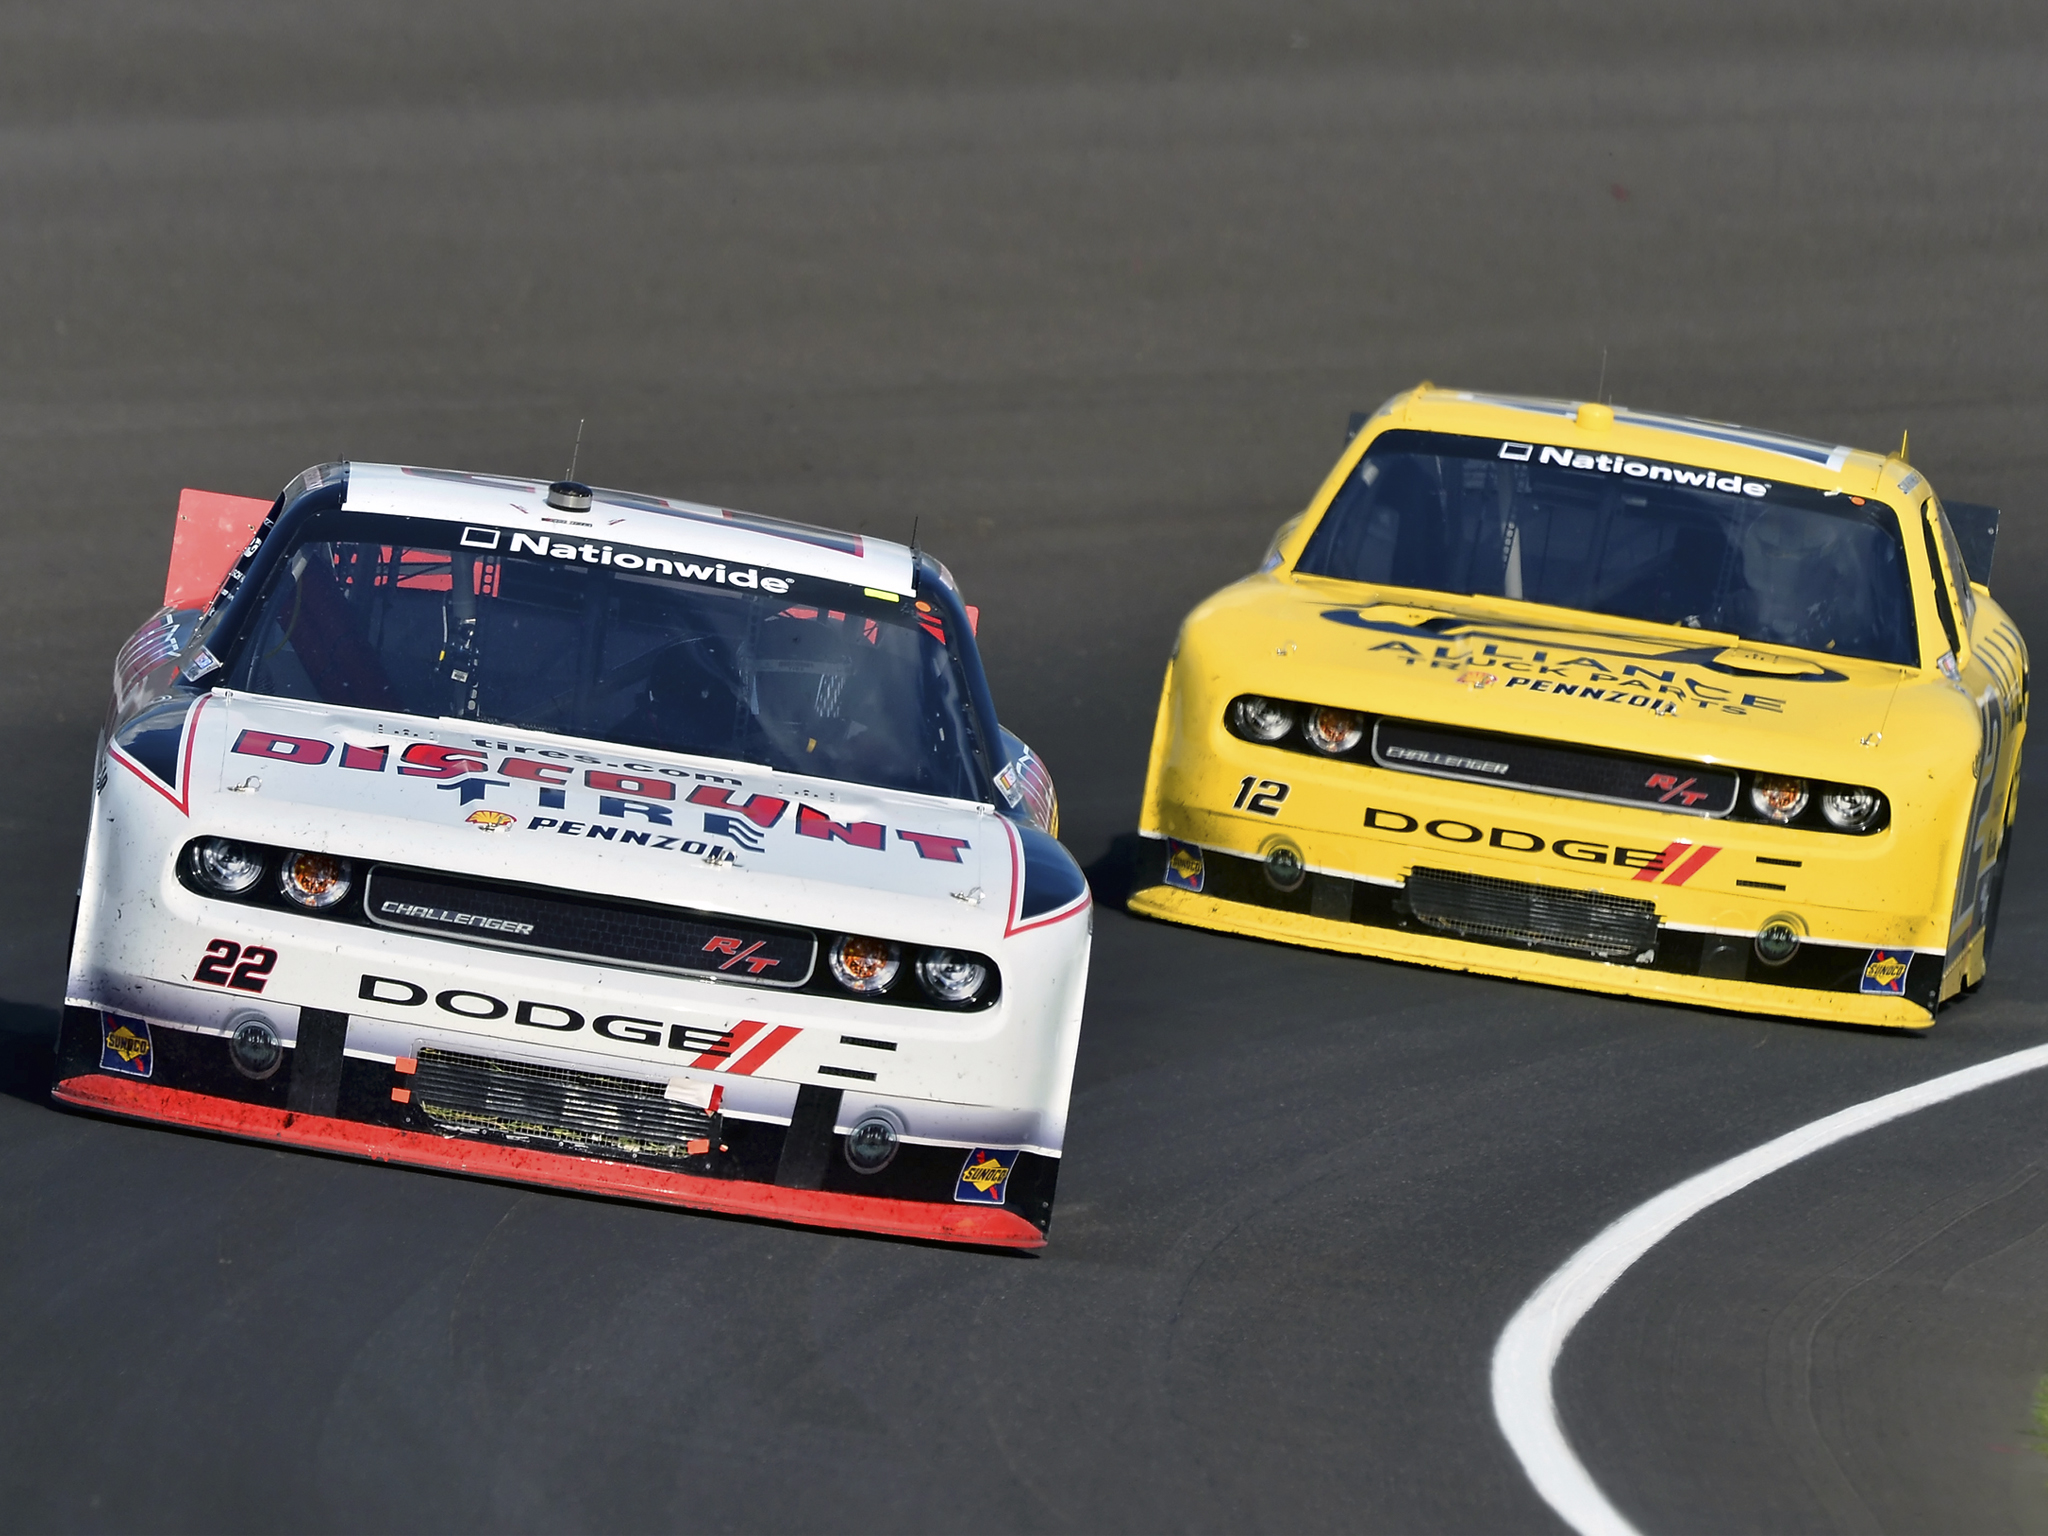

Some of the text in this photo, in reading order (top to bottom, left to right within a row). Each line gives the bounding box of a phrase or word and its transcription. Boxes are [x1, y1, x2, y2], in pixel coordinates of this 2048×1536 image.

[1539, 446, 1767, 497] Nationwide
[509, 532, 790, 594] Nationwide
[1367, 641, 1786, 713] ALLIANCE
[1398, 655, 1747, 715] TRUCK PARTS
[471, 738, 742, 786] tires.com
[1385, 745, 1509, 775] CHALLENGER
[230, 728, 971, 864] DISCOUNT
[1232, 774, 1291, 817] 12
[1645, 772, 1708, 806] R/T
[436, 777, 766, 853] TIRE
[1363, 807, 1666, 872] DODGE
[380, 900, 535, 937] CHALLENGER
[192, 937, 278, 994] 22
[702, 935, 780, 975] R/T
[1867, 963, 1905, 977] SUNOCO
[358, 973, 735, 1058] DODGE
[107, 1033, 148, 1054] SUNOCO
[963, 1166, 1008, 1182] SUNOCO
